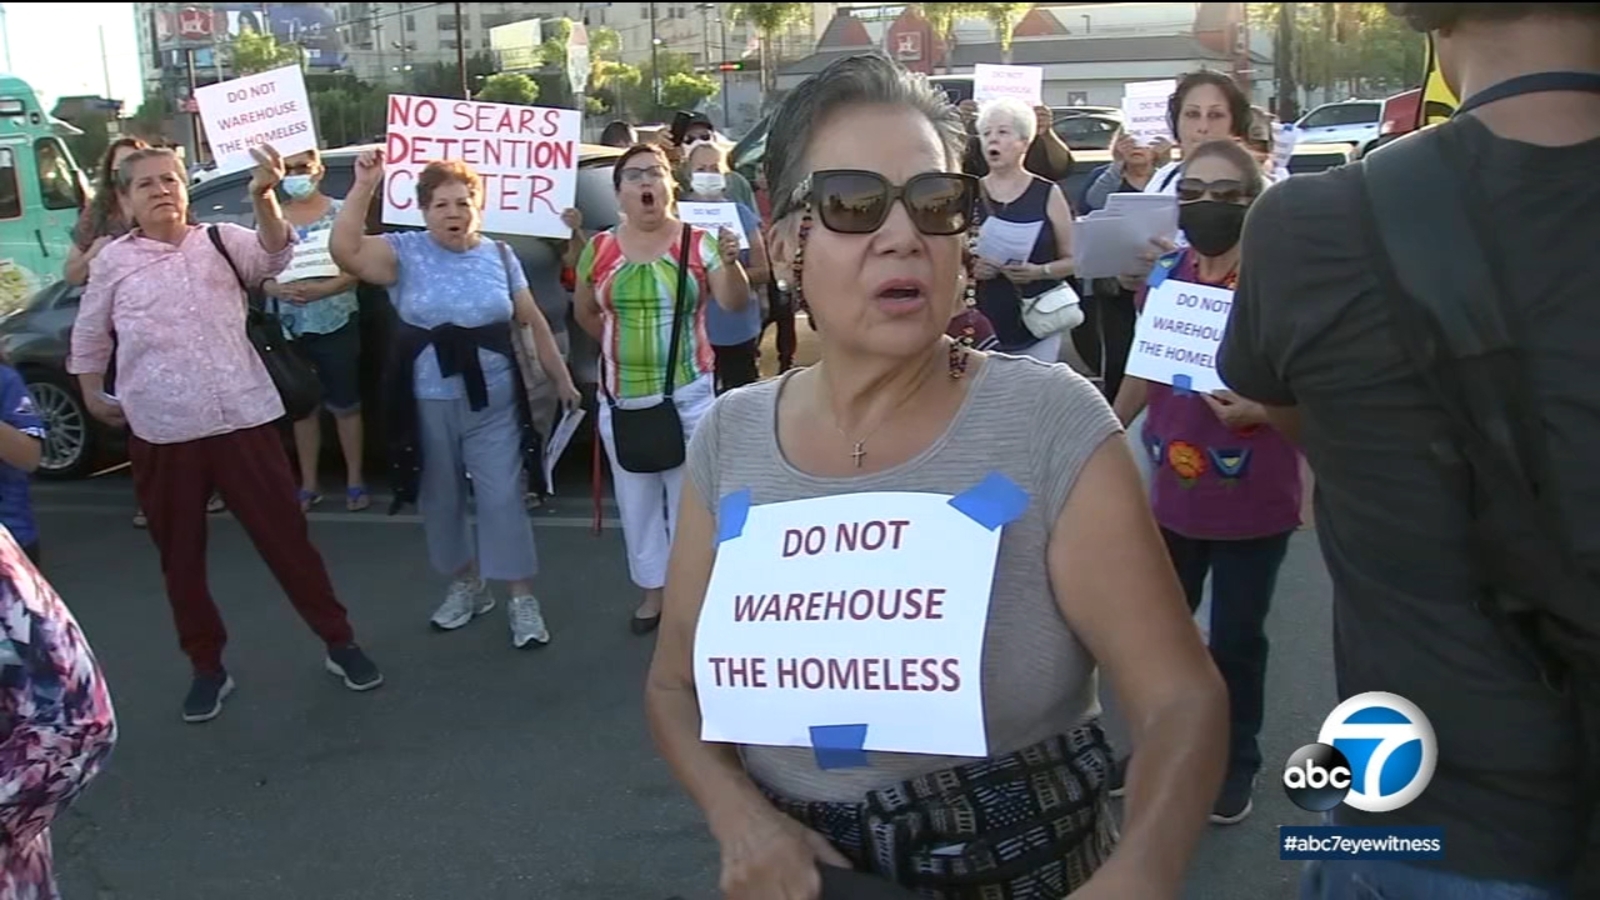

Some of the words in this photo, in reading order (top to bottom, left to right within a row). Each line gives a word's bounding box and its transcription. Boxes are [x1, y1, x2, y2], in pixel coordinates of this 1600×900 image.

[227, 89, 247, 103] DO
[250, 81, 276, 97] NOT
[218, 100, 297, 130] WAREHOUSE
[389, 96, 437, 127] NO
[453, 102, 560, 137] SEARS
[217, 139, 243, 154] THE
[245, 121, 308, 147] HOMELESS
[386, 132, 574, 170] DETENTION
[387, 169, 562, 214] CTER
[1176, 293, 1198, 308] DO
[1200, 297, 1231, 314] NOT
[1153, 316, 1224, 342] WAREHOU
[1138, 340, 1164, 357] THE
[1165, 346, 1215, 369] HOMEL
[782, 525, 826, 558] DO
[835, 520, 910, 552] NOT
[733, 588, 946, 622] WAREHOUSE
[709, 657, 767, 688] THE
[777, 657, 961, 692] HOMELESS
